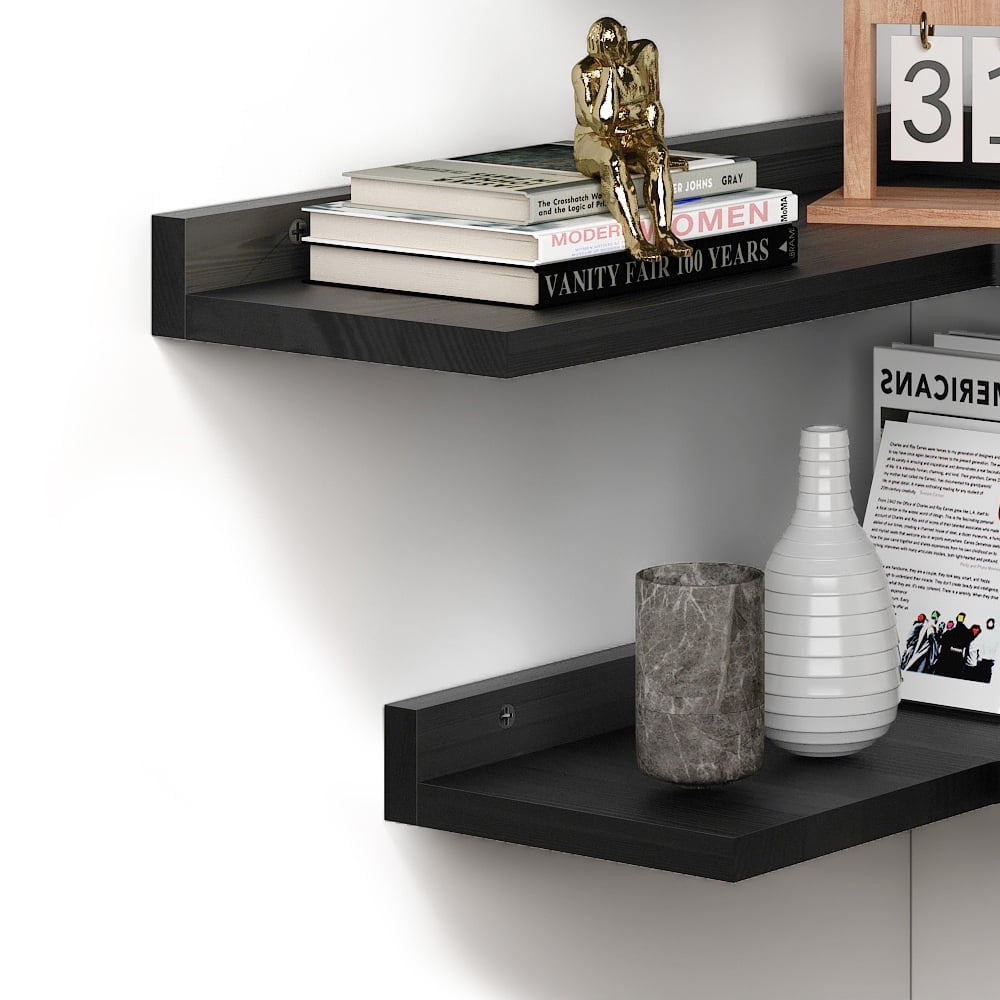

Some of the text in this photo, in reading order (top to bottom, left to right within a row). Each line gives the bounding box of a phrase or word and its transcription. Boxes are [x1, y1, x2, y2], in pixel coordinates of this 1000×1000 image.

[903, 59, 952, 144] 3
[686, 178, 713, 192] JOHNS
[722, 172, 744, 186] GRAY
[538, 200, 550, 208] The
[553, 194, 588, 206] Crosshatch
[538, 208, 552, 216] and
[554, 205, 566, 214] the
[568, 202, 585, 213] Logic
[552, 223, 620, 248] MODER
[544, 238, 769, 298] VANITY FAIR 100 YEARS
